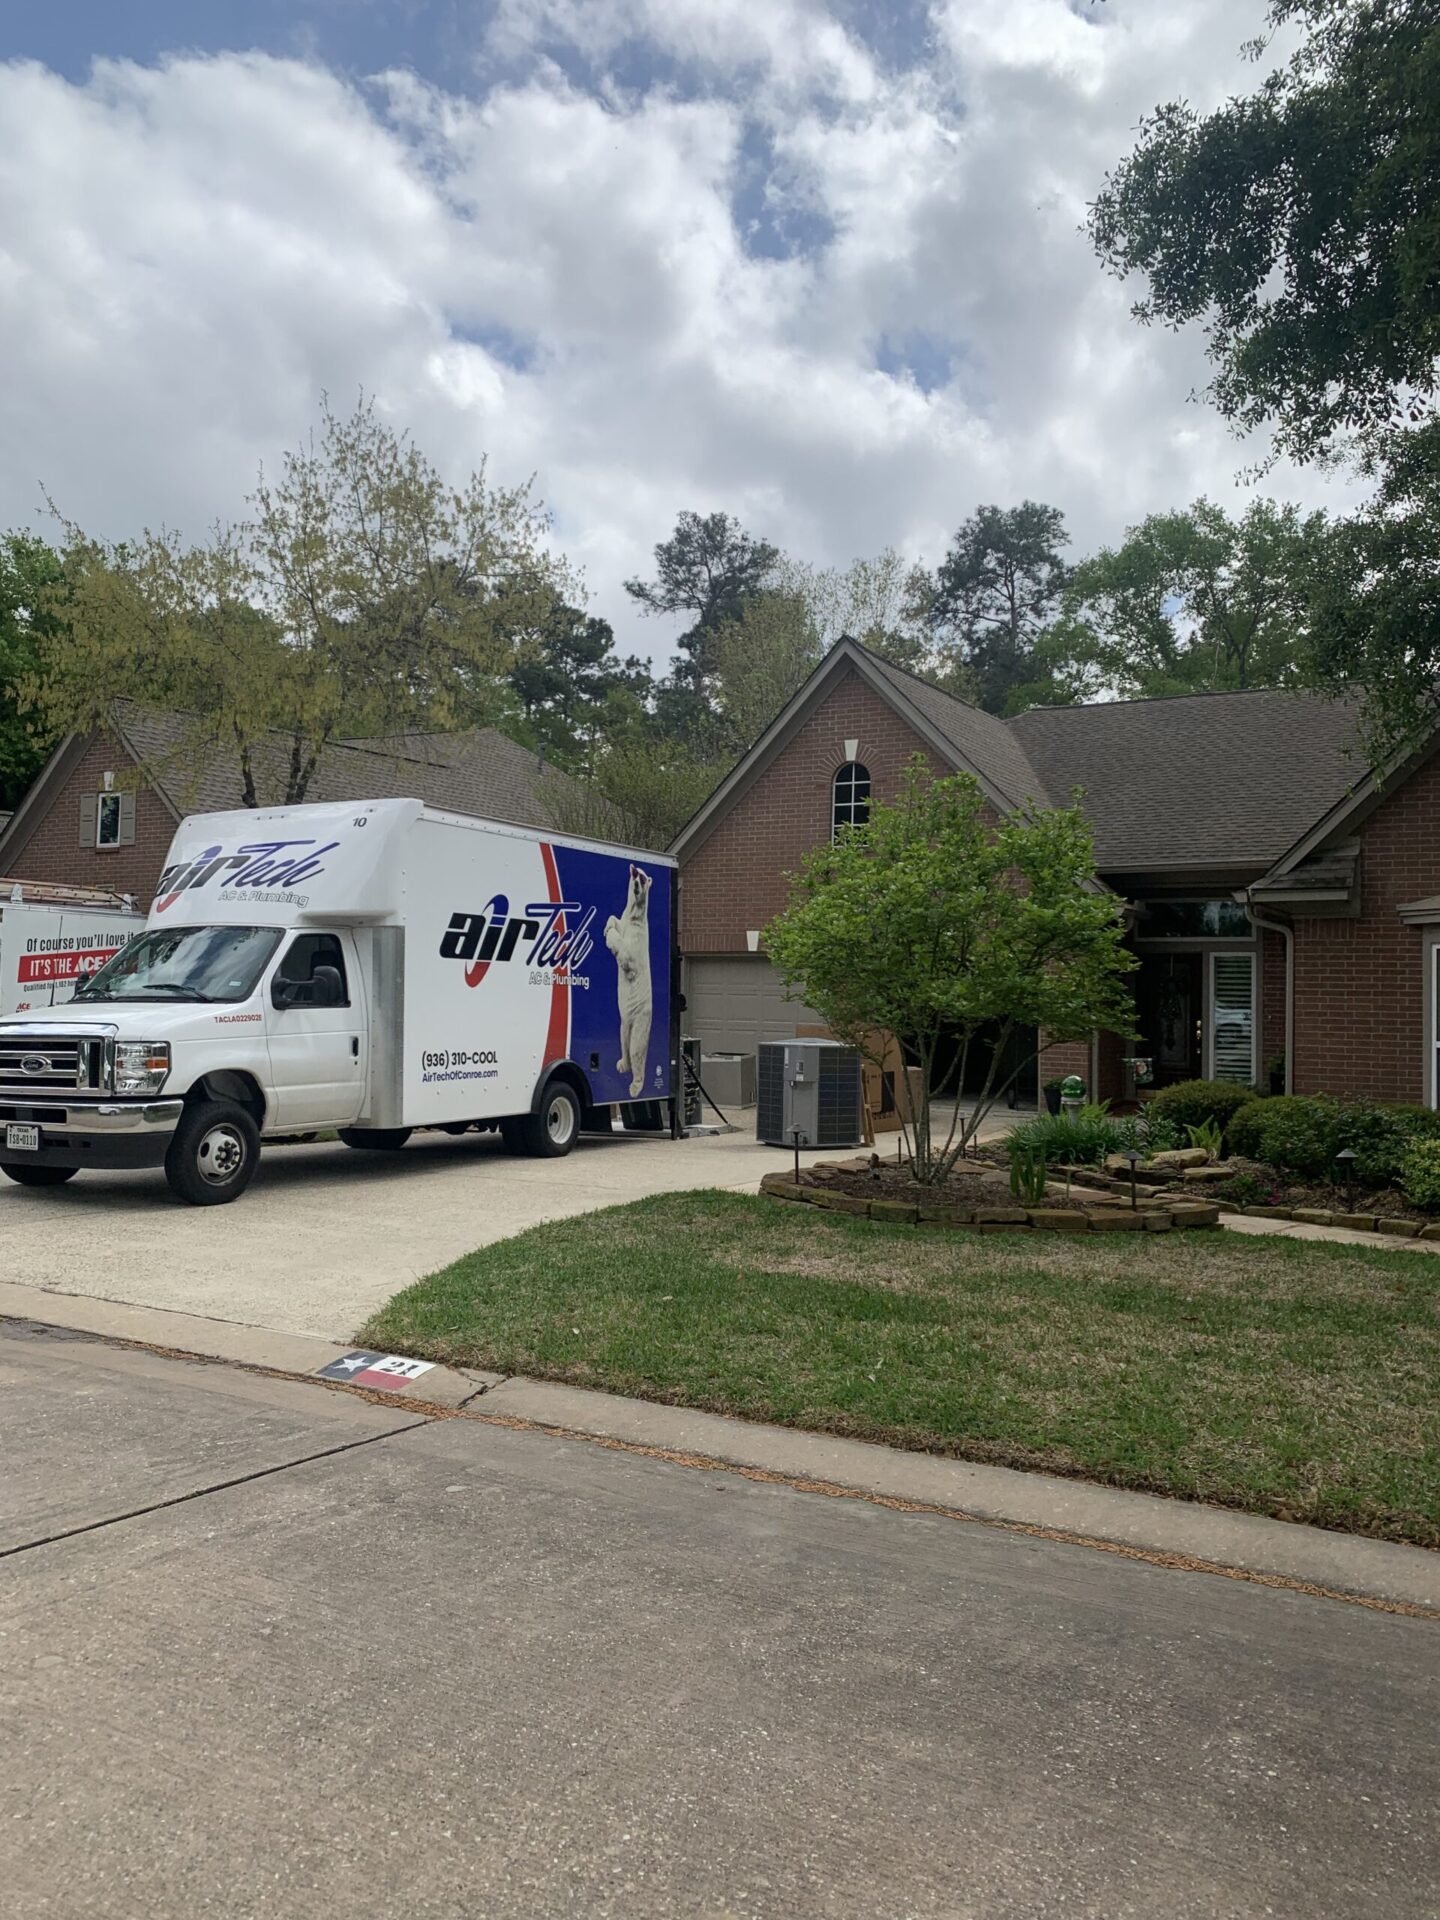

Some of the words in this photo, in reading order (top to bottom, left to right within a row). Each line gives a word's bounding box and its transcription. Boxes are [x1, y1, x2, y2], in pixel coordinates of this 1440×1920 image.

[353, 817, 367, 827] 10
[217, 890, 237, 902] AC
[237, 890, 247, 902] &
[248, 890, 309, 908] Plumbing
[26, 938, 38, 952] Of
[39, 937, 74, 950] course
[76, 933, 104, 951] you'll
[105, 933, 125, 947] love
[30, 958, 51, 976] IT'S
[53, 957, 72, 975] THE
[73, 955, 104, 973] ACE
[528, 971, 542, 985] AC
[543, 971, 551, 986] &
[551, 973, 590, 990] Plumbing
[16, 1002, 31, 1010] ACE
[422, 1049, 449, 1071] (936)
[451, 1051, 498, 1066] 310-COOL
[422, 1069, 498, 1083] AirTechOfConroe.com
